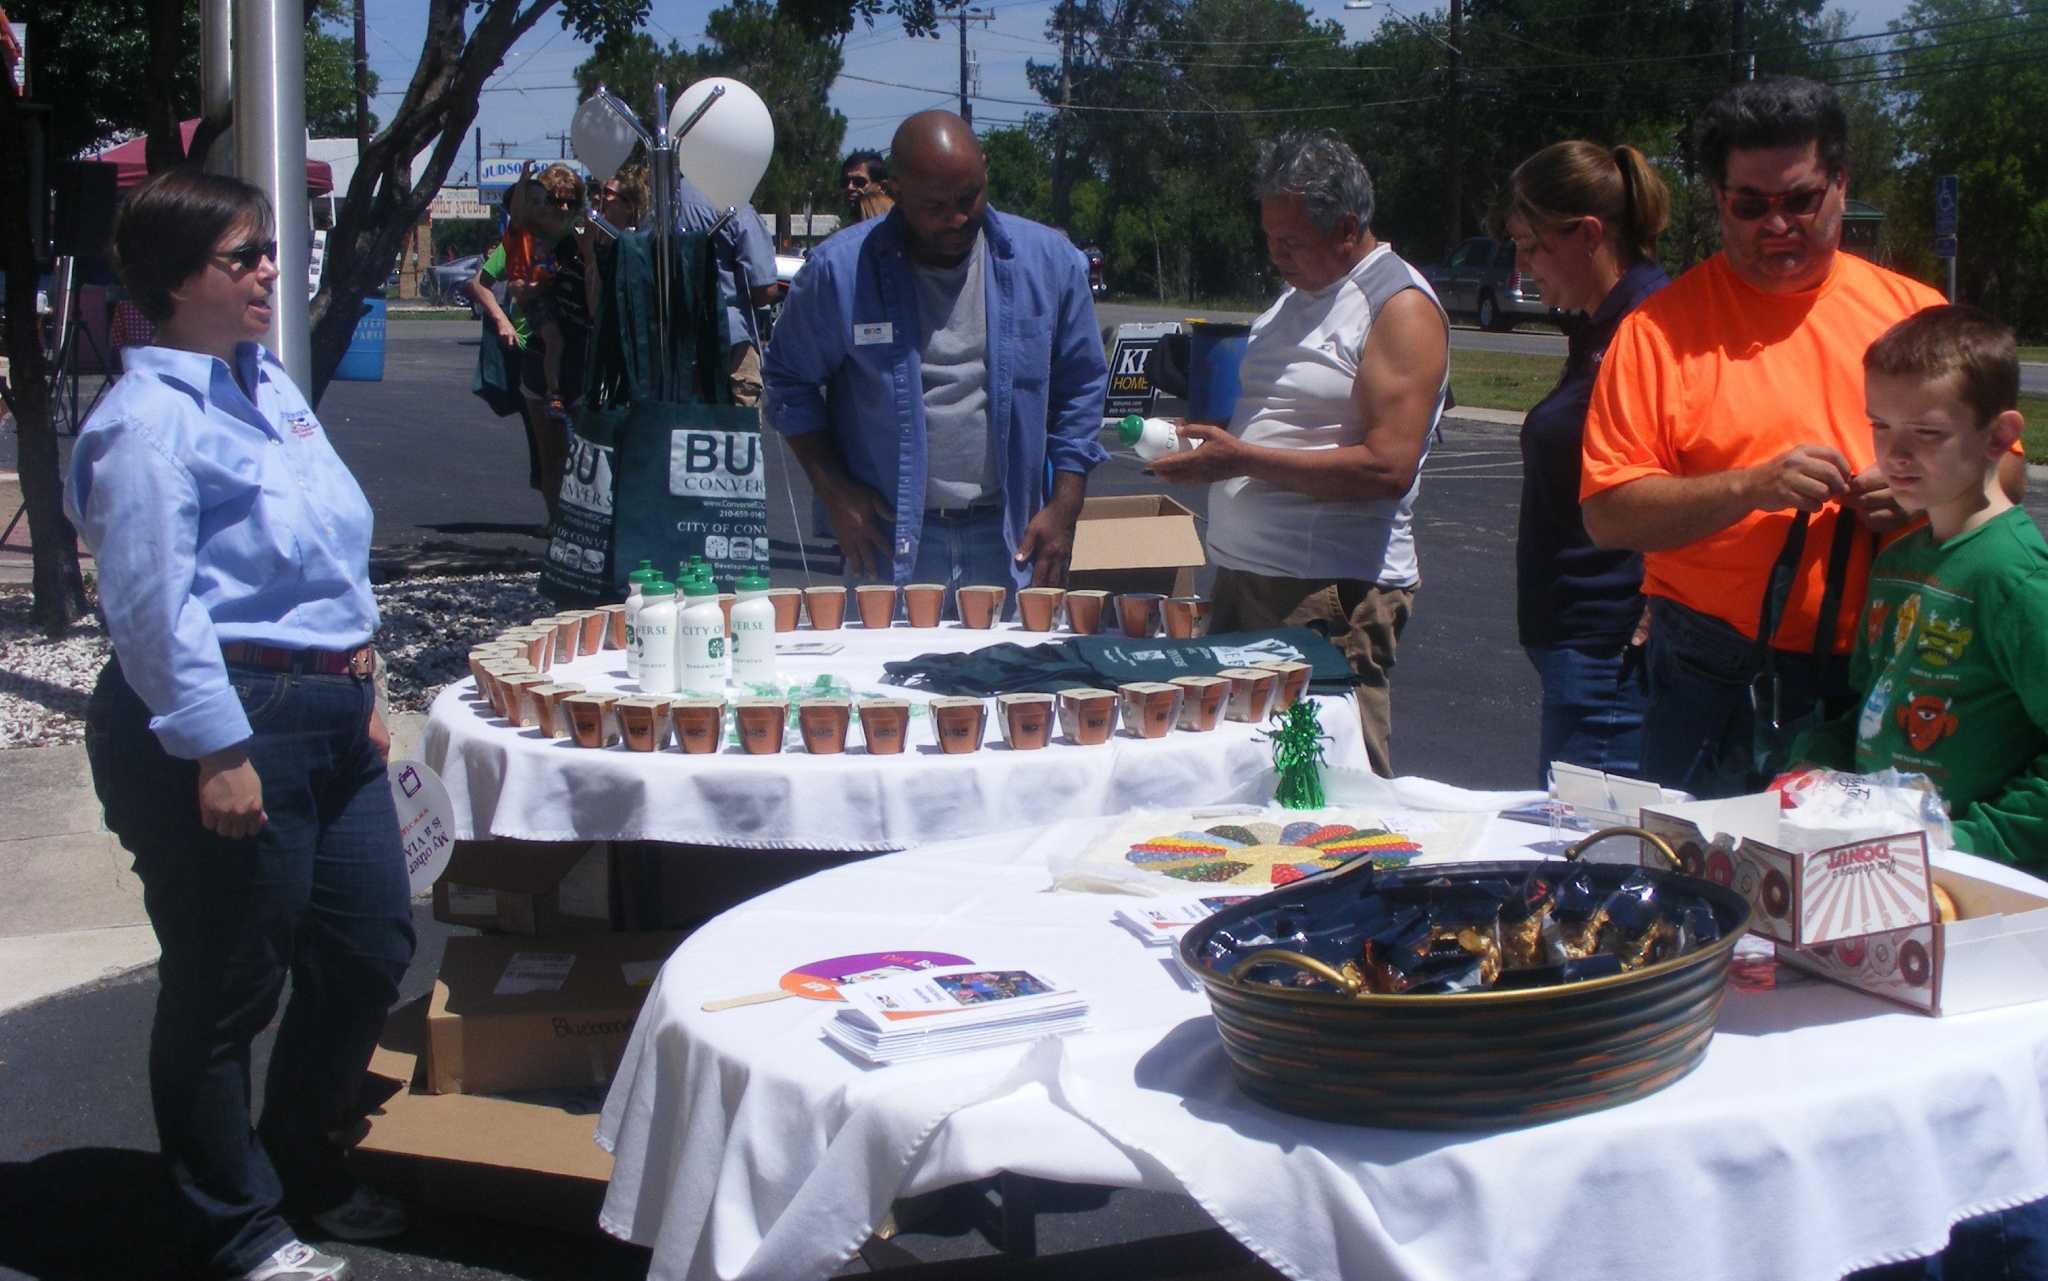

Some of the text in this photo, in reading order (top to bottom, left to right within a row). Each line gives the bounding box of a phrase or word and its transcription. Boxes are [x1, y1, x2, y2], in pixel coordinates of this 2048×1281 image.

[482, 163, 524, 179] JUDSO
[1113, 376, 1149, 390] HOME
[685, 433, 757, 476] BU
[677, 521, 708, 533] CITY
[712, 522, 730, 534] OF
[682, 625, 709, 637] CITY
[403, 834, 427, 858] VIA
[408, 830, 450, 875] My other
[1826, 842, 1889, 870] DONUT
